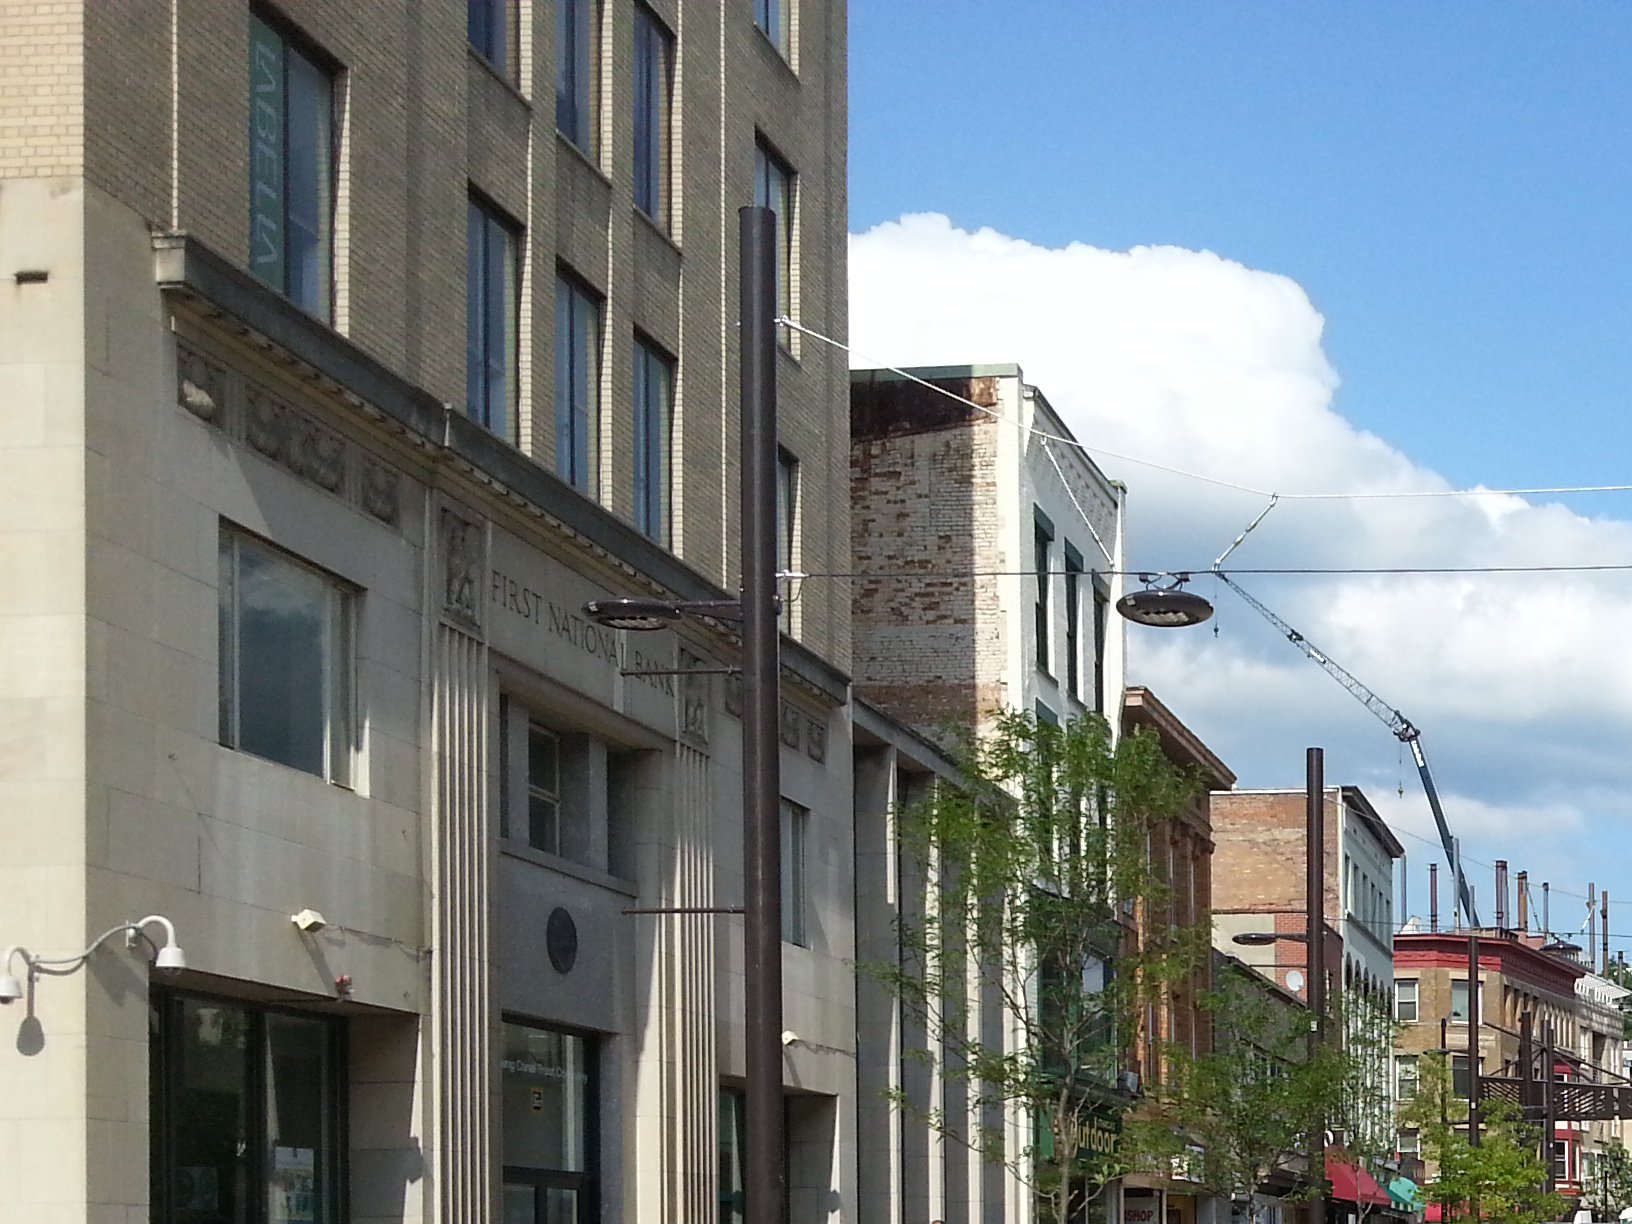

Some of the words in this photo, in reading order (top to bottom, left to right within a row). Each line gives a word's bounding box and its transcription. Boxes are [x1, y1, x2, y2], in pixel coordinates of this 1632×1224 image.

[492, 569, 542, 625] FIRST
[549, 602, 627, 670] NATIONAL
[635, 650, 676, 698] BANK
[1124, 1209, 1154, 1223] SHOP
